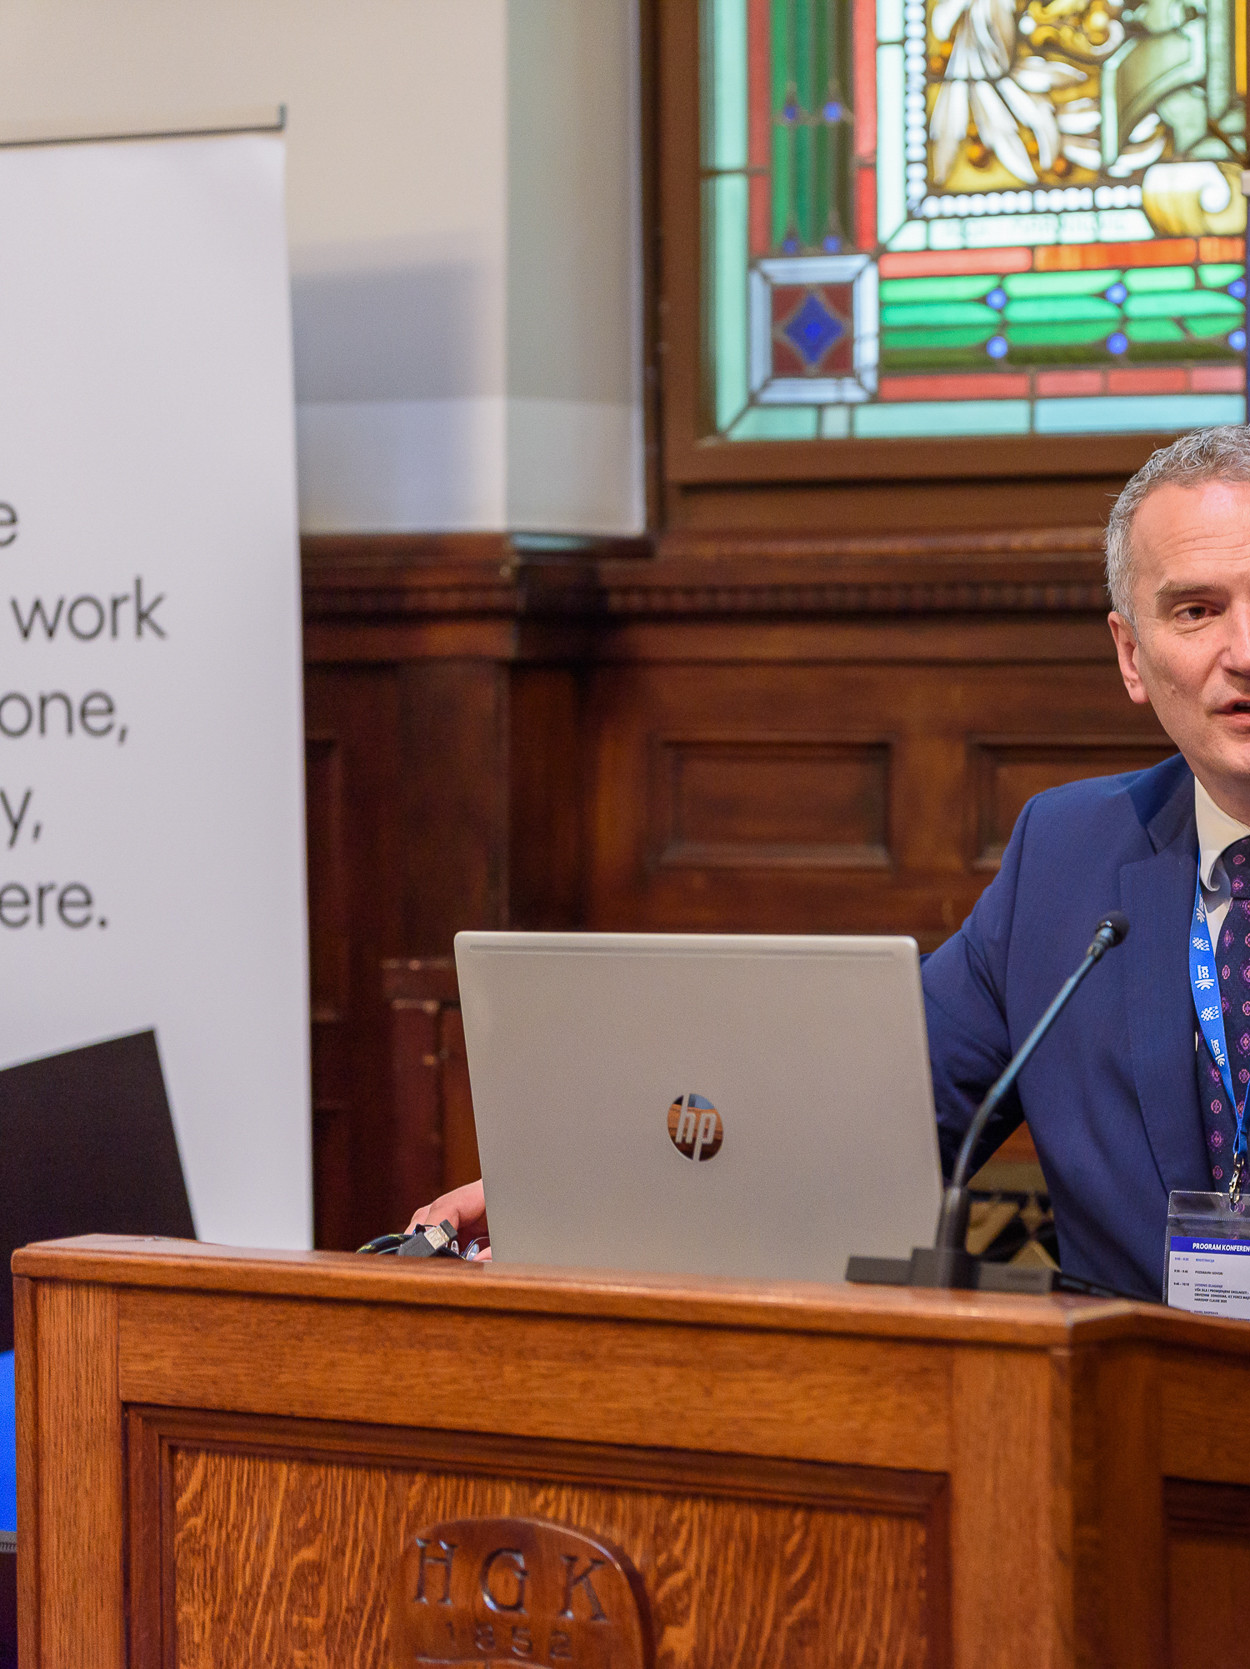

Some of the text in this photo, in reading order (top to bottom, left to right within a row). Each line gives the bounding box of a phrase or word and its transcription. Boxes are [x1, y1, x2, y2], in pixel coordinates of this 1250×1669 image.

[11, 576, 167, 642] work
[0, 691, 128, 745] one,
[674, 1093, 717, 1161] hp
[1192, 1242, 1221, 1251] PROGRAM
